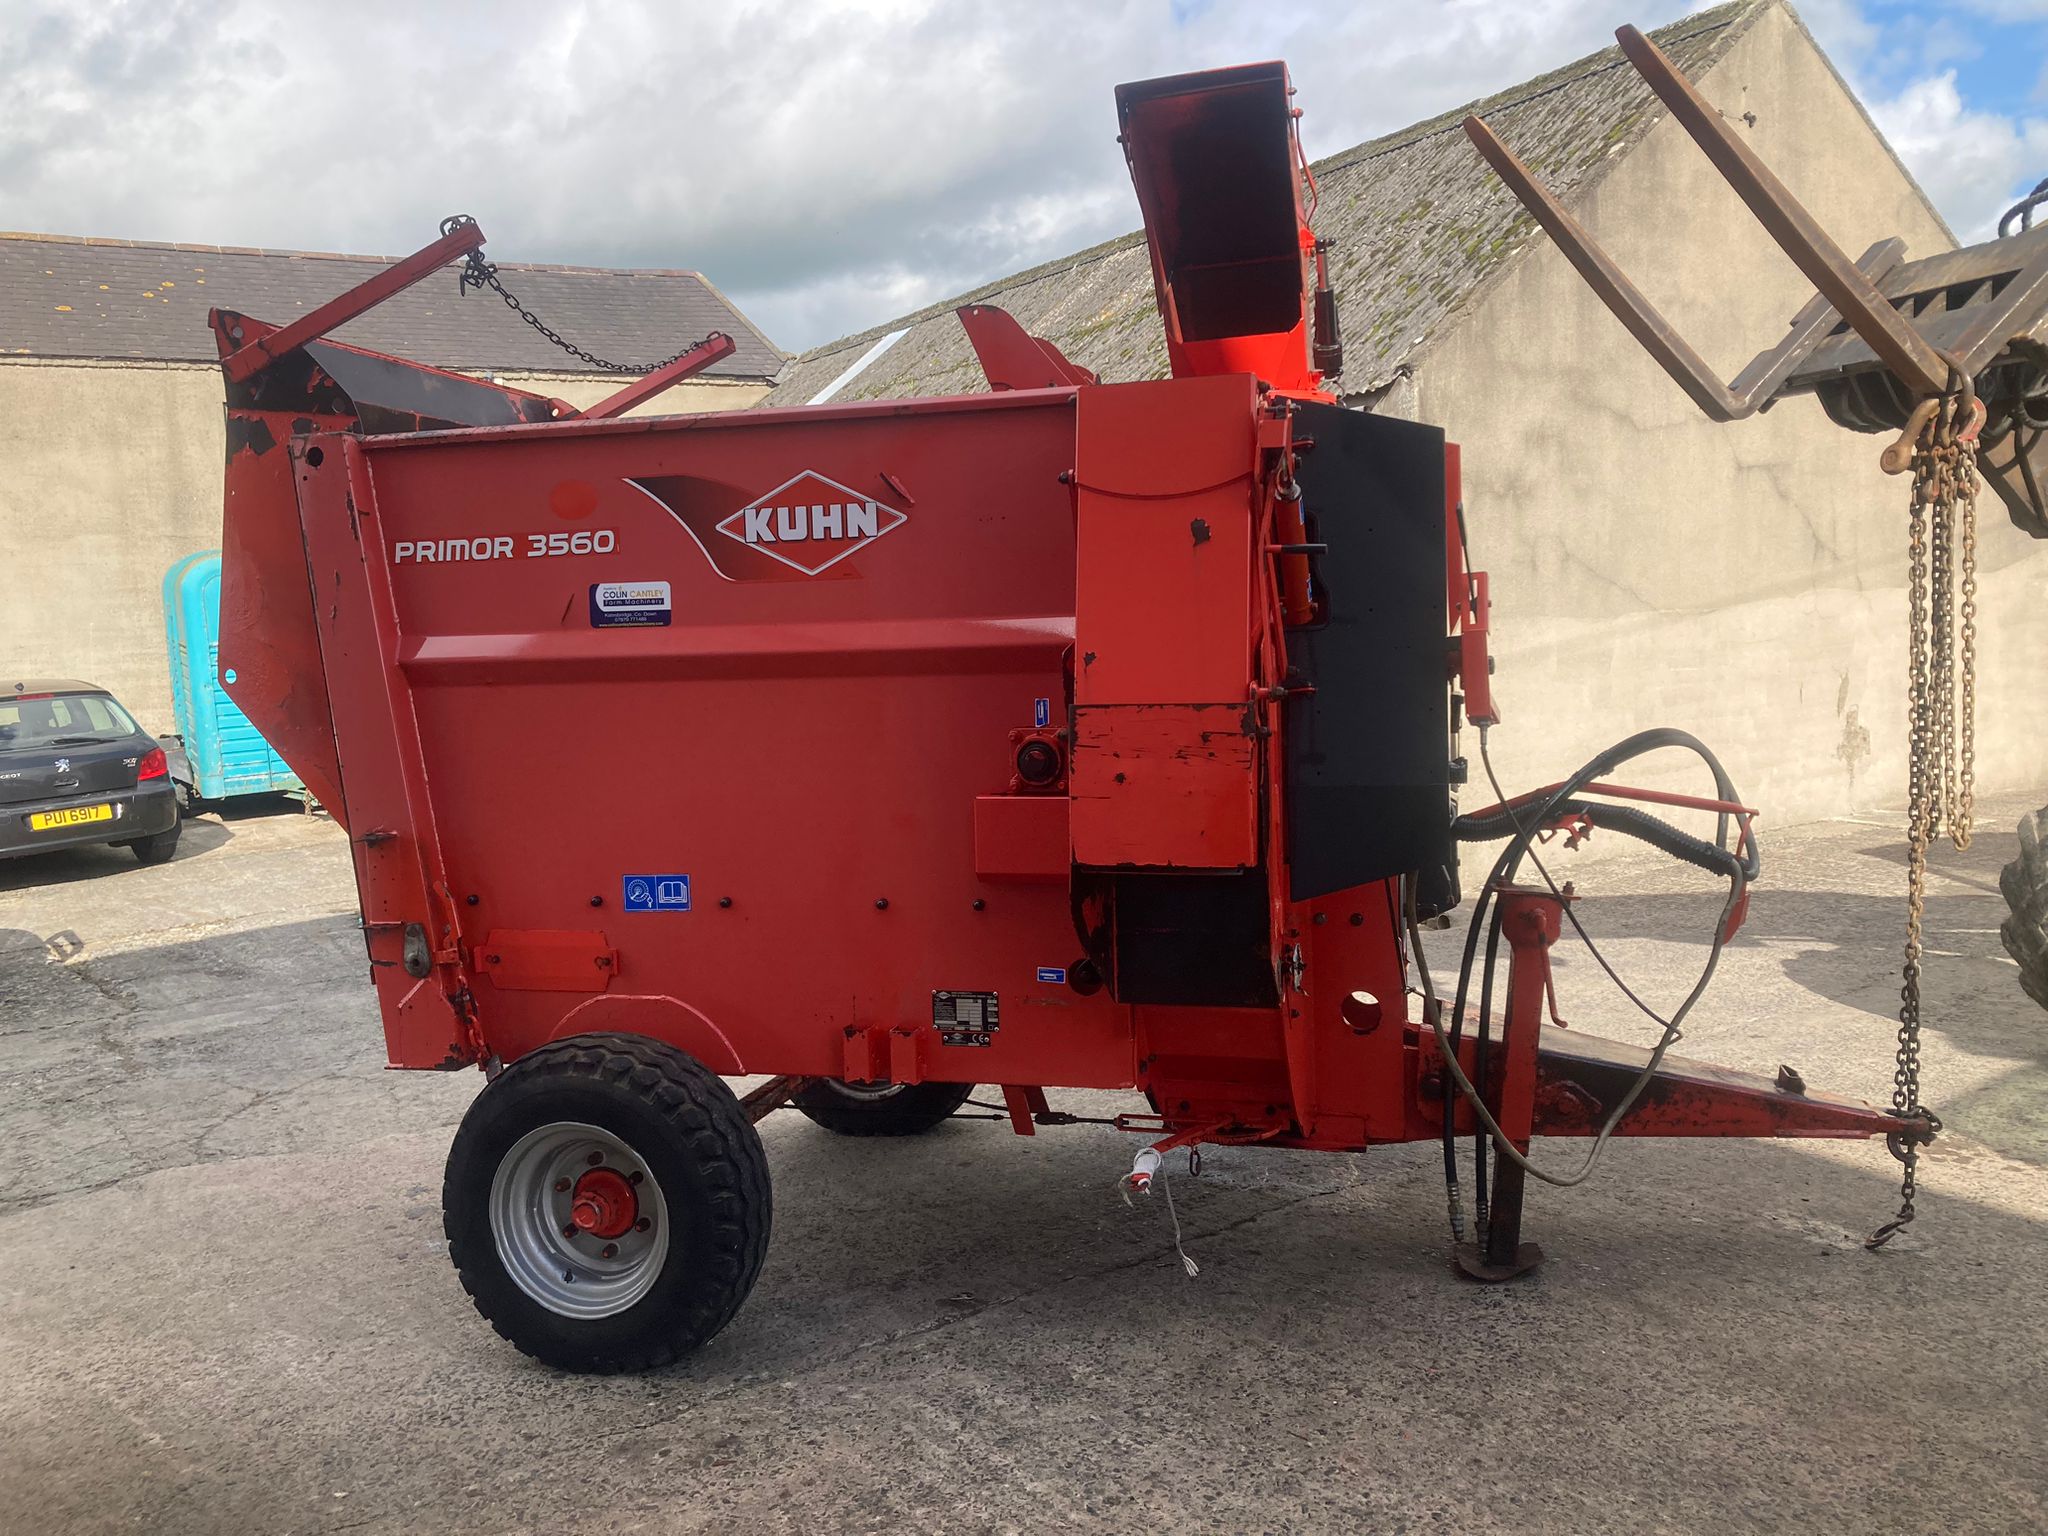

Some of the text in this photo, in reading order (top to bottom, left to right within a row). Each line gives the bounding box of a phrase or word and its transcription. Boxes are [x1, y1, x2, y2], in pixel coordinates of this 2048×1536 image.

[744, 501, 879, 544] KUHN
[394, 529, 615, 564] PRIMOR 3560
[603, 589, 664, 599] COLIN CANTLEY
[70, 807, 99, 822] 6917
